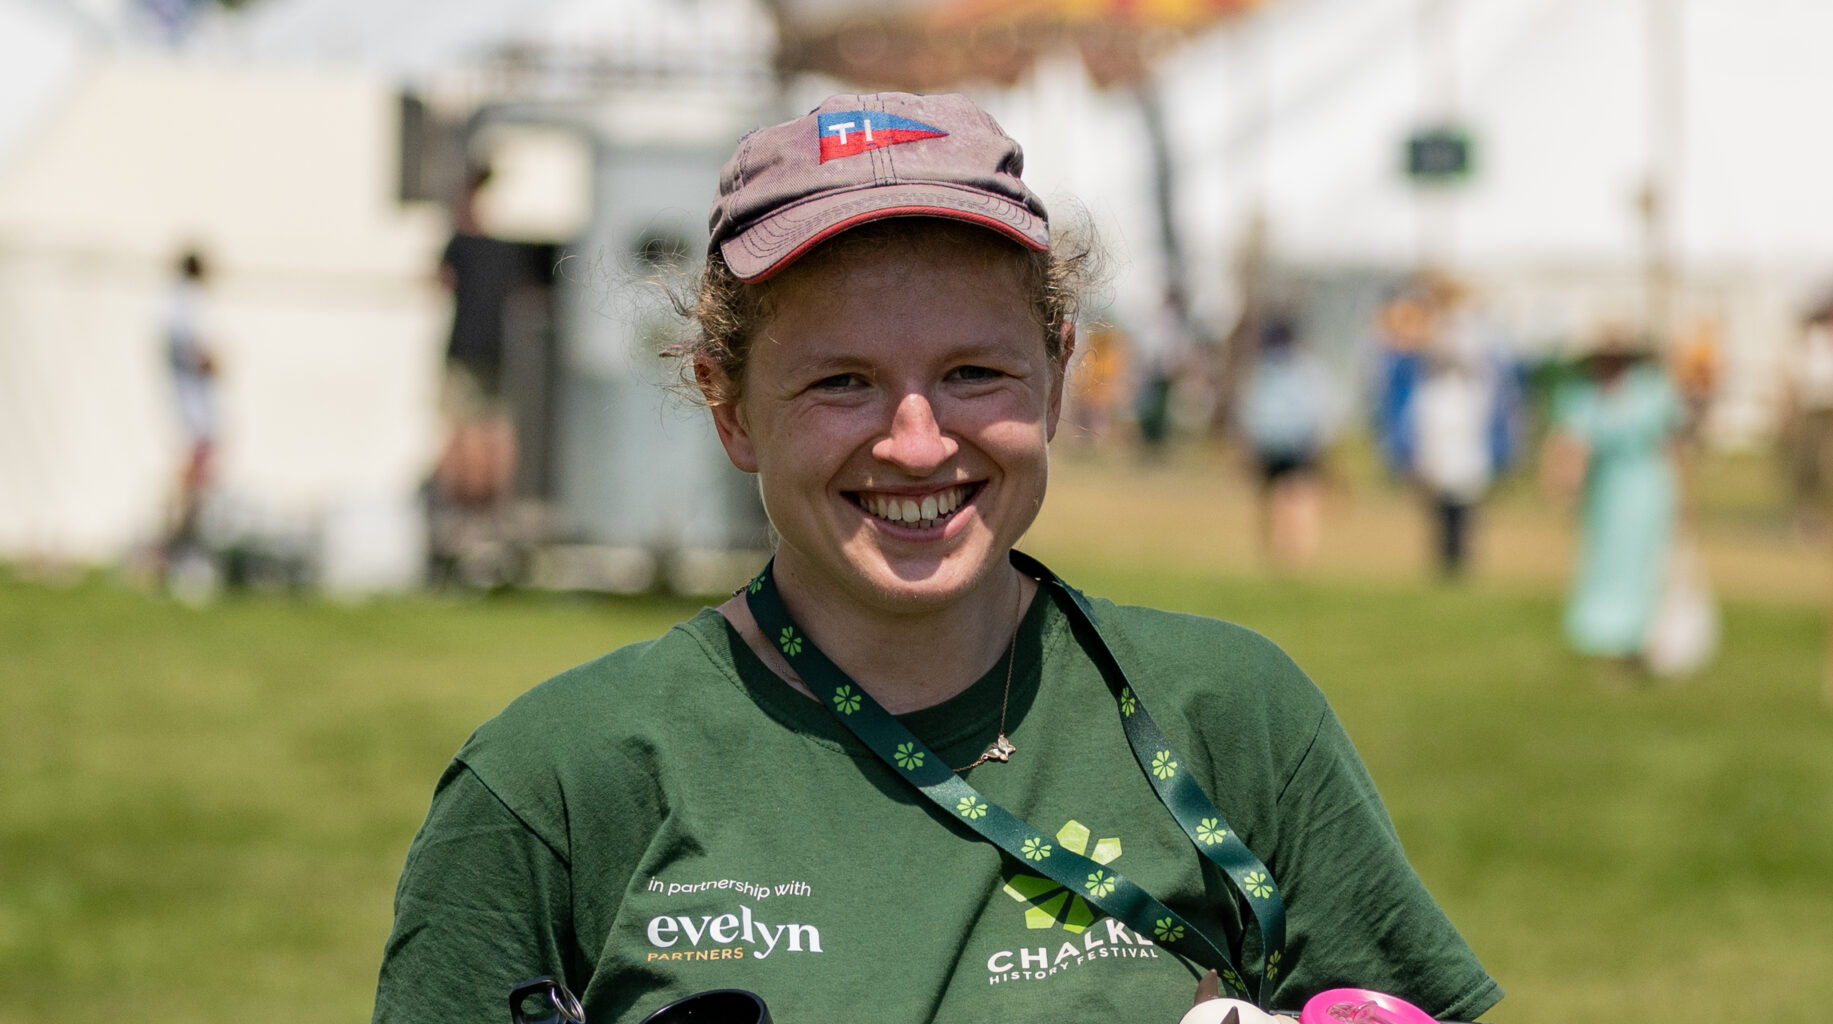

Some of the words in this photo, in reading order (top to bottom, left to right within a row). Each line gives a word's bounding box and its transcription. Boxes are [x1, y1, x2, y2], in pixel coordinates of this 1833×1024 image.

[648, 876, 664, 895] in
[667, 879, 770, 900] partnership
[774, 880, 811, 897] with
[647, 904, 823, 959] evelyn
[647, 947, 744, 962] PARTNERS
[989, 961, 1069, 985] HISTORY
[1077, 947, 1158, 966] FESTIVAL
